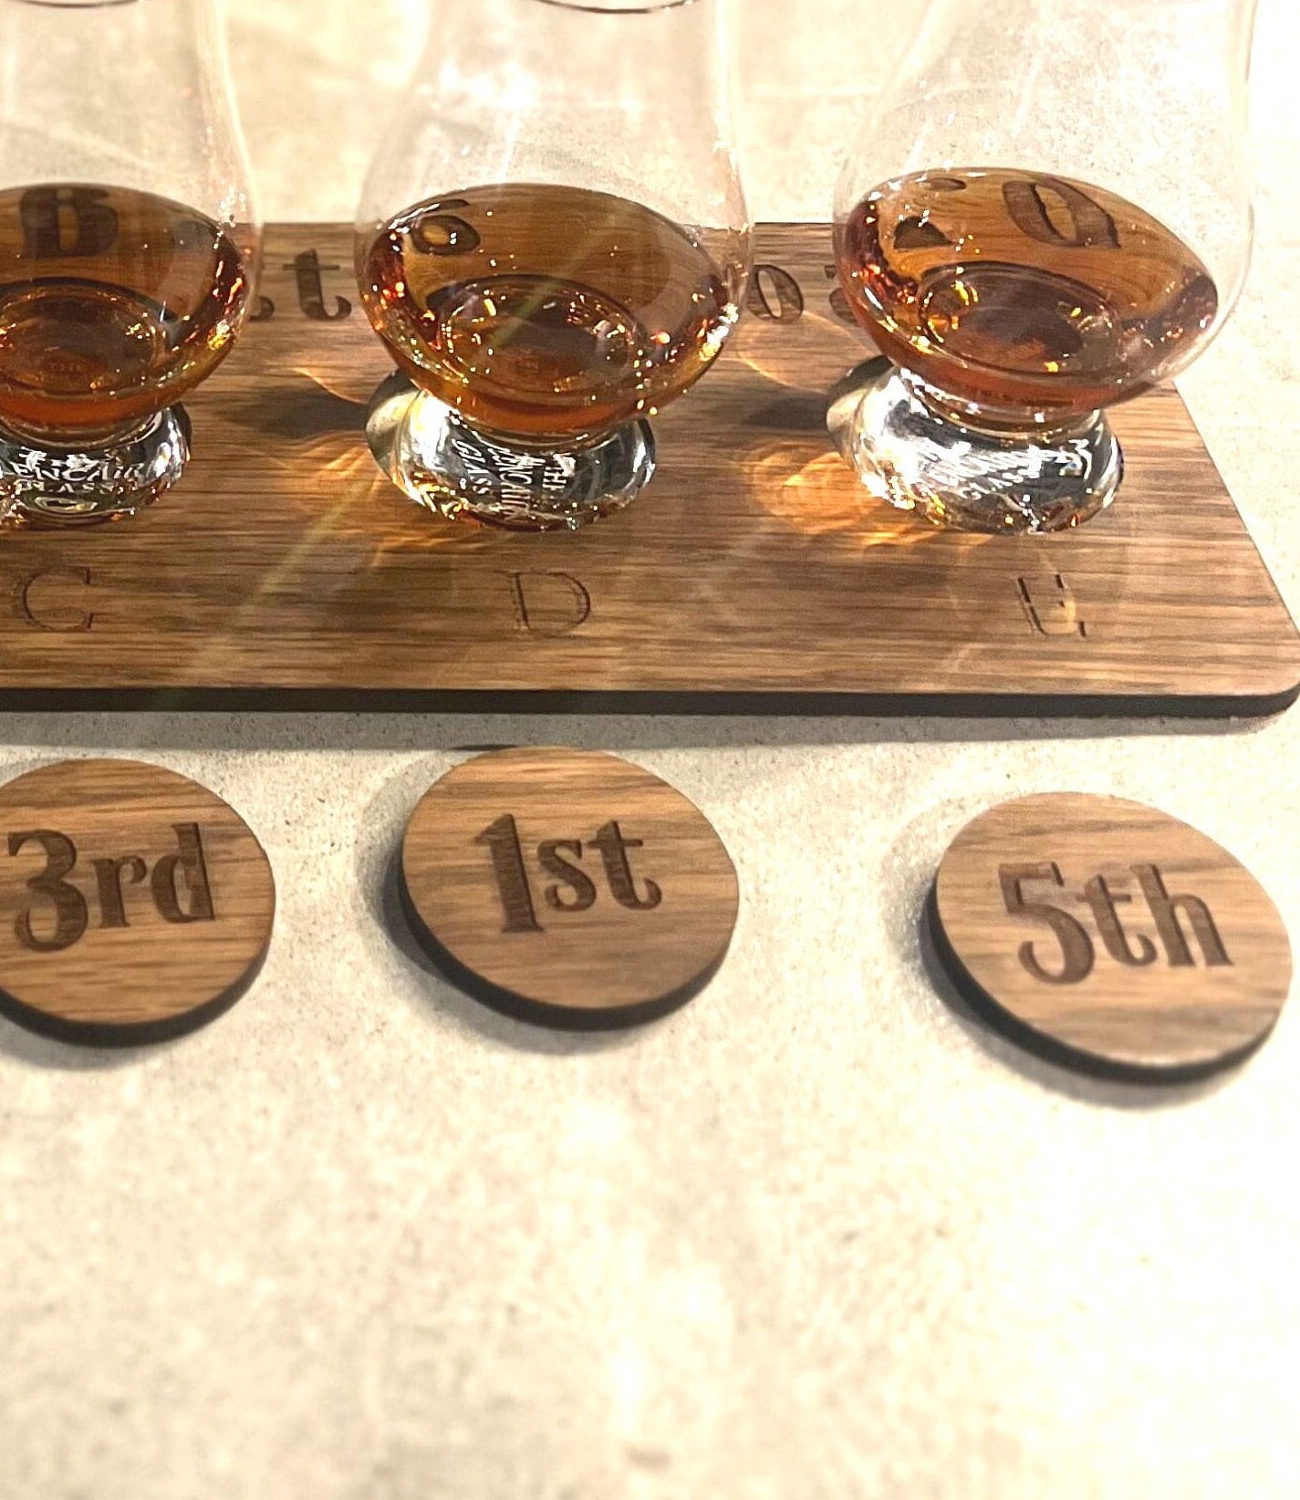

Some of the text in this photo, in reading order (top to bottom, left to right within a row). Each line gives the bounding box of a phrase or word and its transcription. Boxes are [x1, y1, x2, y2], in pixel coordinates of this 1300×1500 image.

[12, 564, 94, 634] C
[502, 571, 592, 636] D
[6, 821, 216, 952] 3rd
[474, 812, 663, 933] 1st
[997, 860, 1235, 984] 5th
